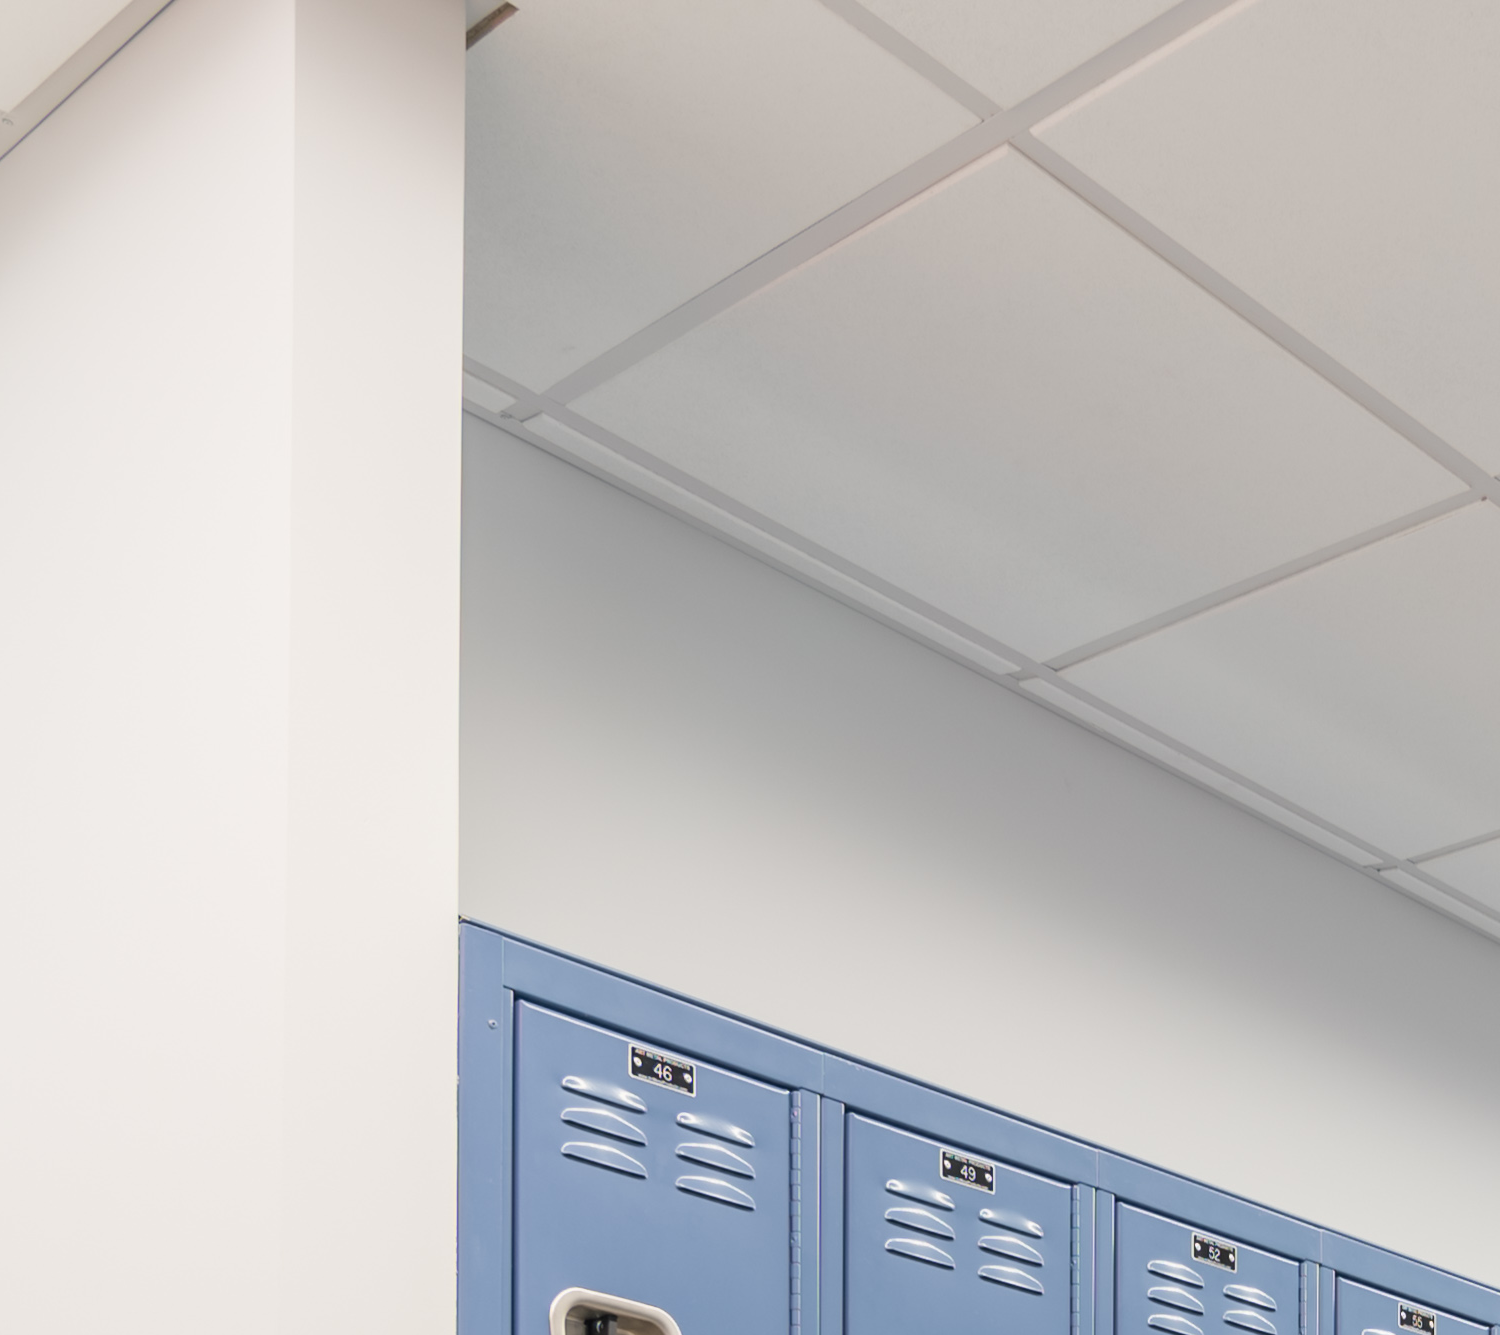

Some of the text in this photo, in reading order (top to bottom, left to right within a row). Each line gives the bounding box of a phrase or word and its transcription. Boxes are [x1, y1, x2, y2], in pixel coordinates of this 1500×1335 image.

[653, 1062, 673, 1082] 46
[960, 1164, 977, 1182] 49
[1208, 1245, 1221, 1262] 52
